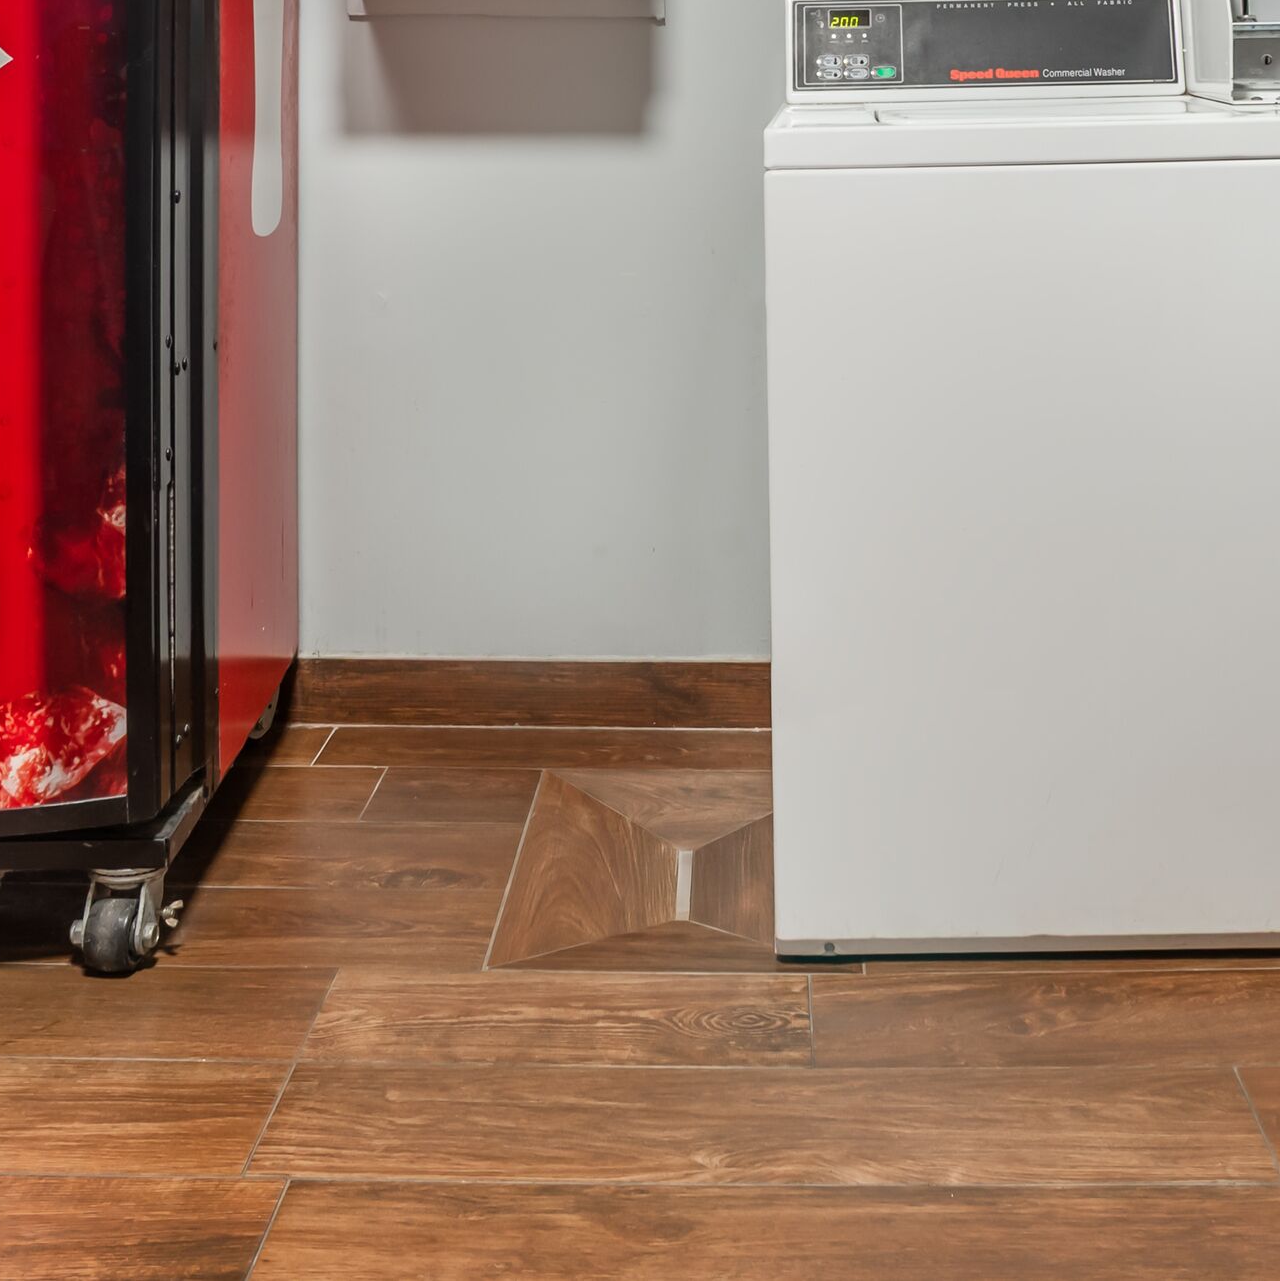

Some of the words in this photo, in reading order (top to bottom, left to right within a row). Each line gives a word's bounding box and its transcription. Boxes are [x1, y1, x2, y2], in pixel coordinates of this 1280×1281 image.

[936, 2, 995, 10] PERMANENT
[949, 68, 993, 82] Speed
[995, 67, 1039, 79] Queen
[1042, 67, 1093, 79] Commercial
[1093, 67, 1126, 78] Washer
